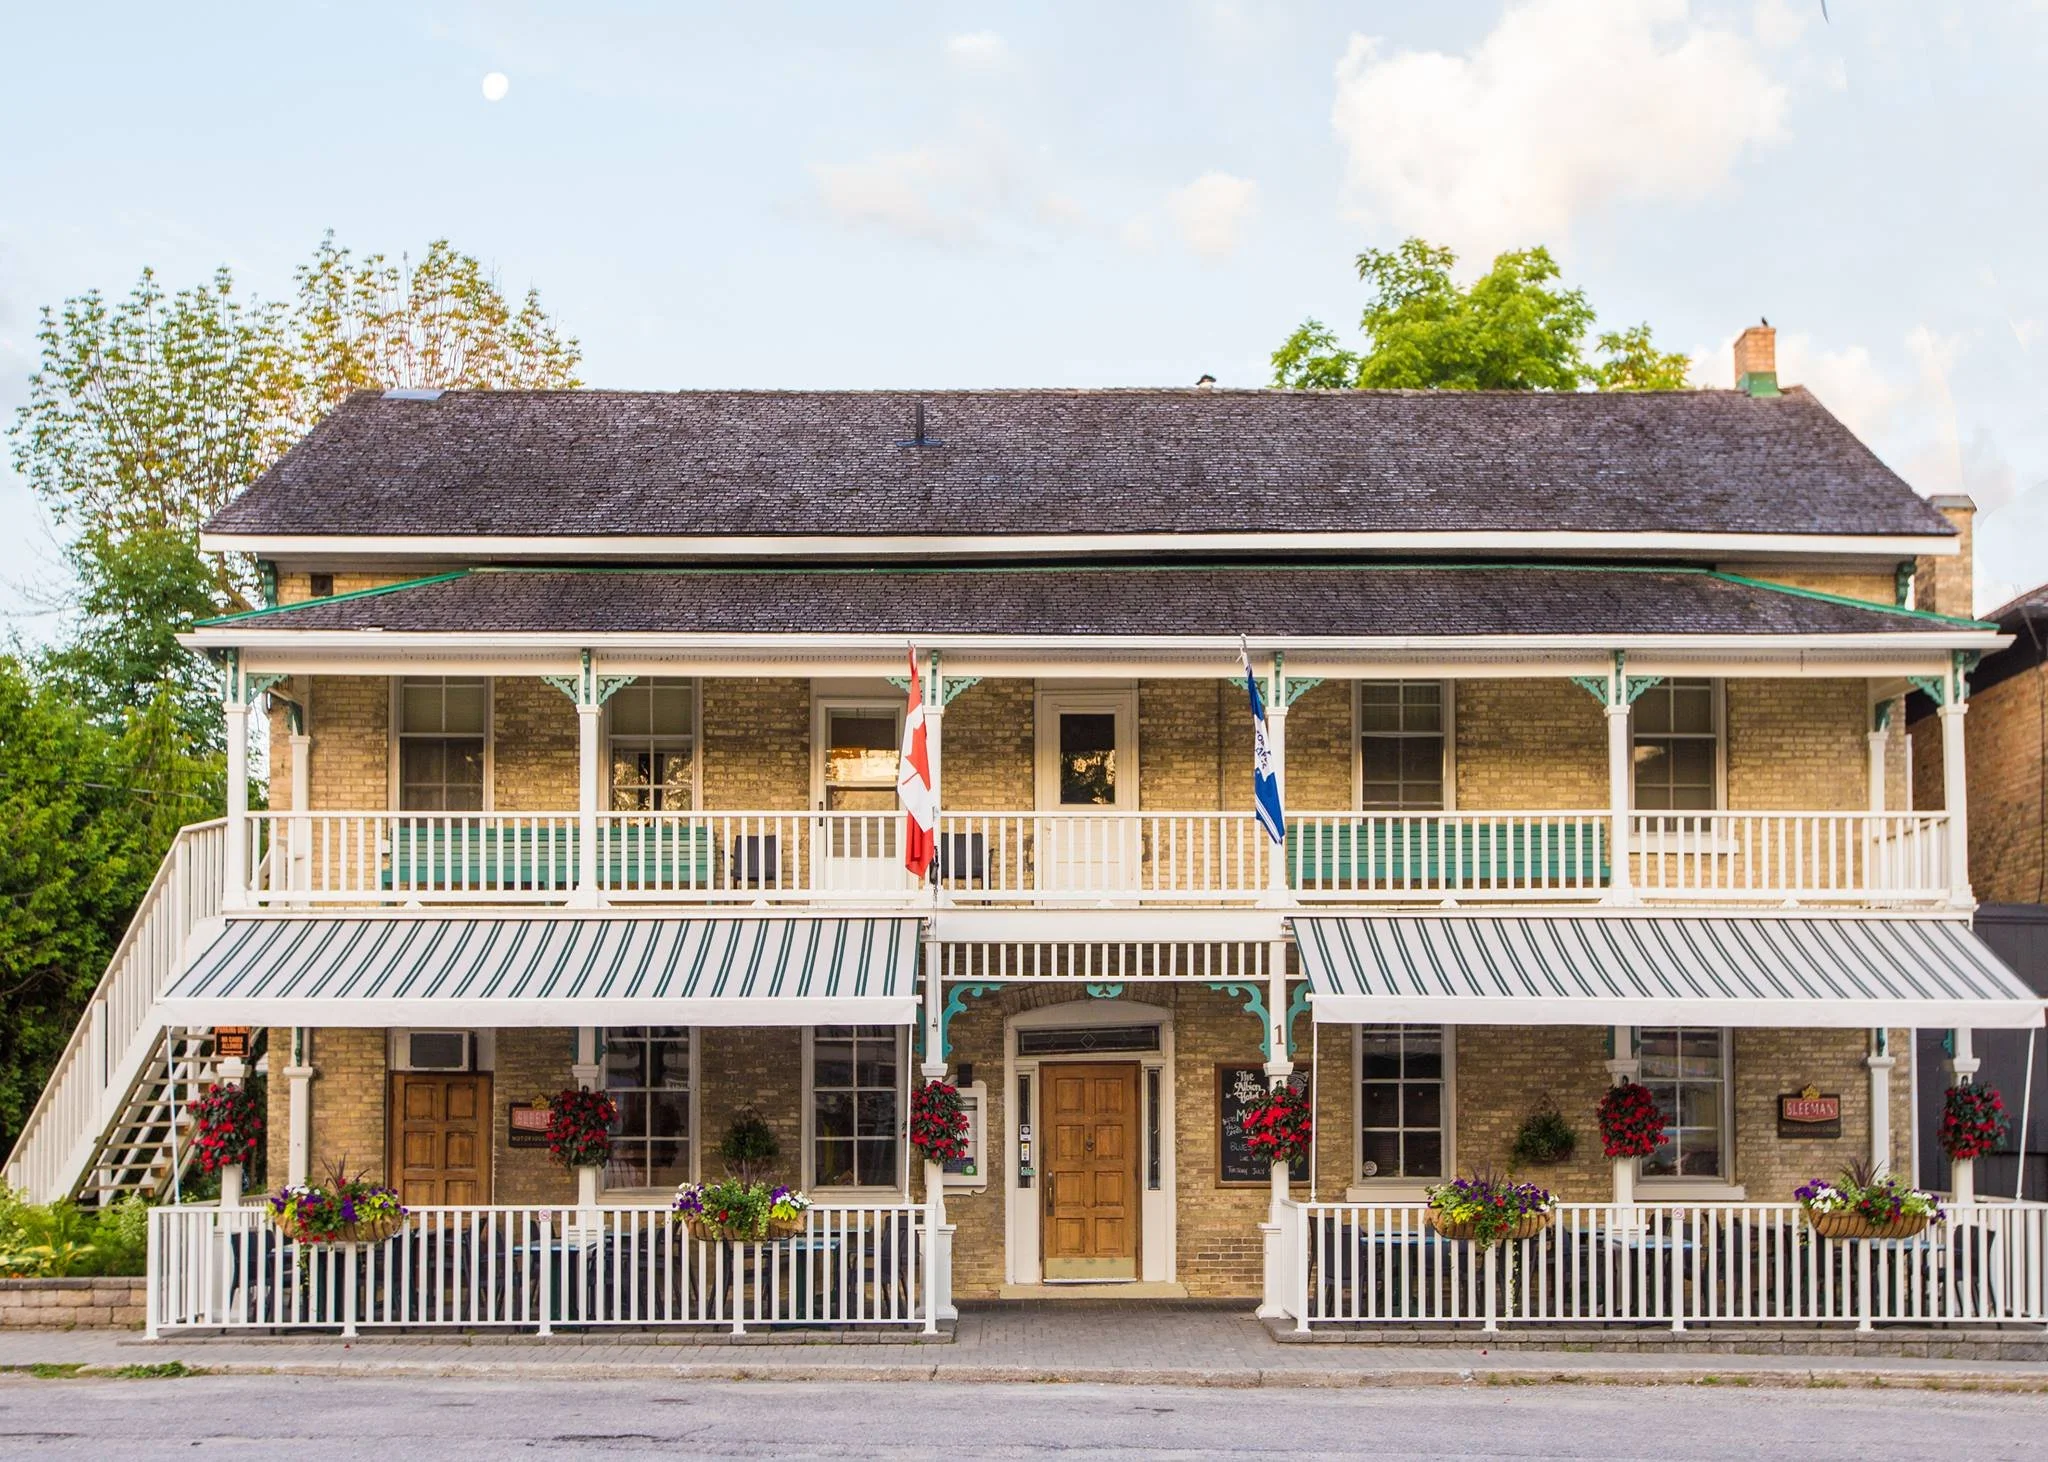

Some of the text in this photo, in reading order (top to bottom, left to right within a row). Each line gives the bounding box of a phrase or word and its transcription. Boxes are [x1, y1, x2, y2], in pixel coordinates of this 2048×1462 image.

[1274, 1023, 1284, 1045] 1
[1236, 1070, 1255, 1081] The
[1233, 1081, 1261, 1093] Albion
